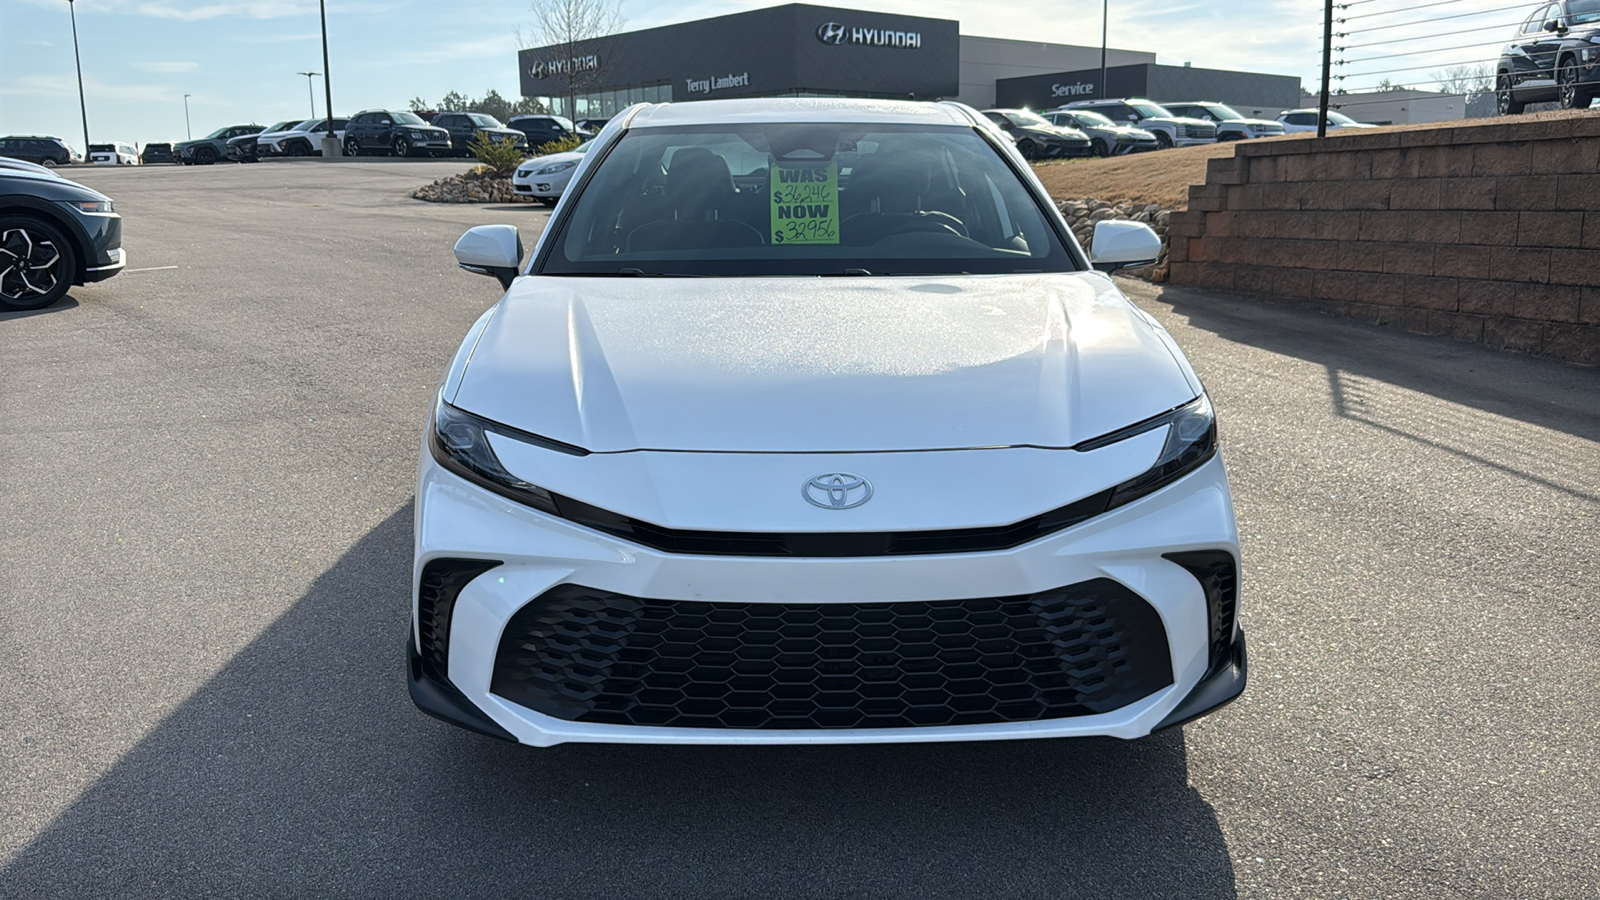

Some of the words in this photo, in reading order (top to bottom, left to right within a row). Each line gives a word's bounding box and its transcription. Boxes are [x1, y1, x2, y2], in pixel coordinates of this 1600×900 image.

[852, 27, 920, 48] HYUNDAI
[686, 79, 709, 94] Terry
[711, 72, 749, 89] Lambert
[1052, 81, 1093, 97] Service
[778, 169, 828, 183] WAS
[778, 205, 829, 219] NOW
